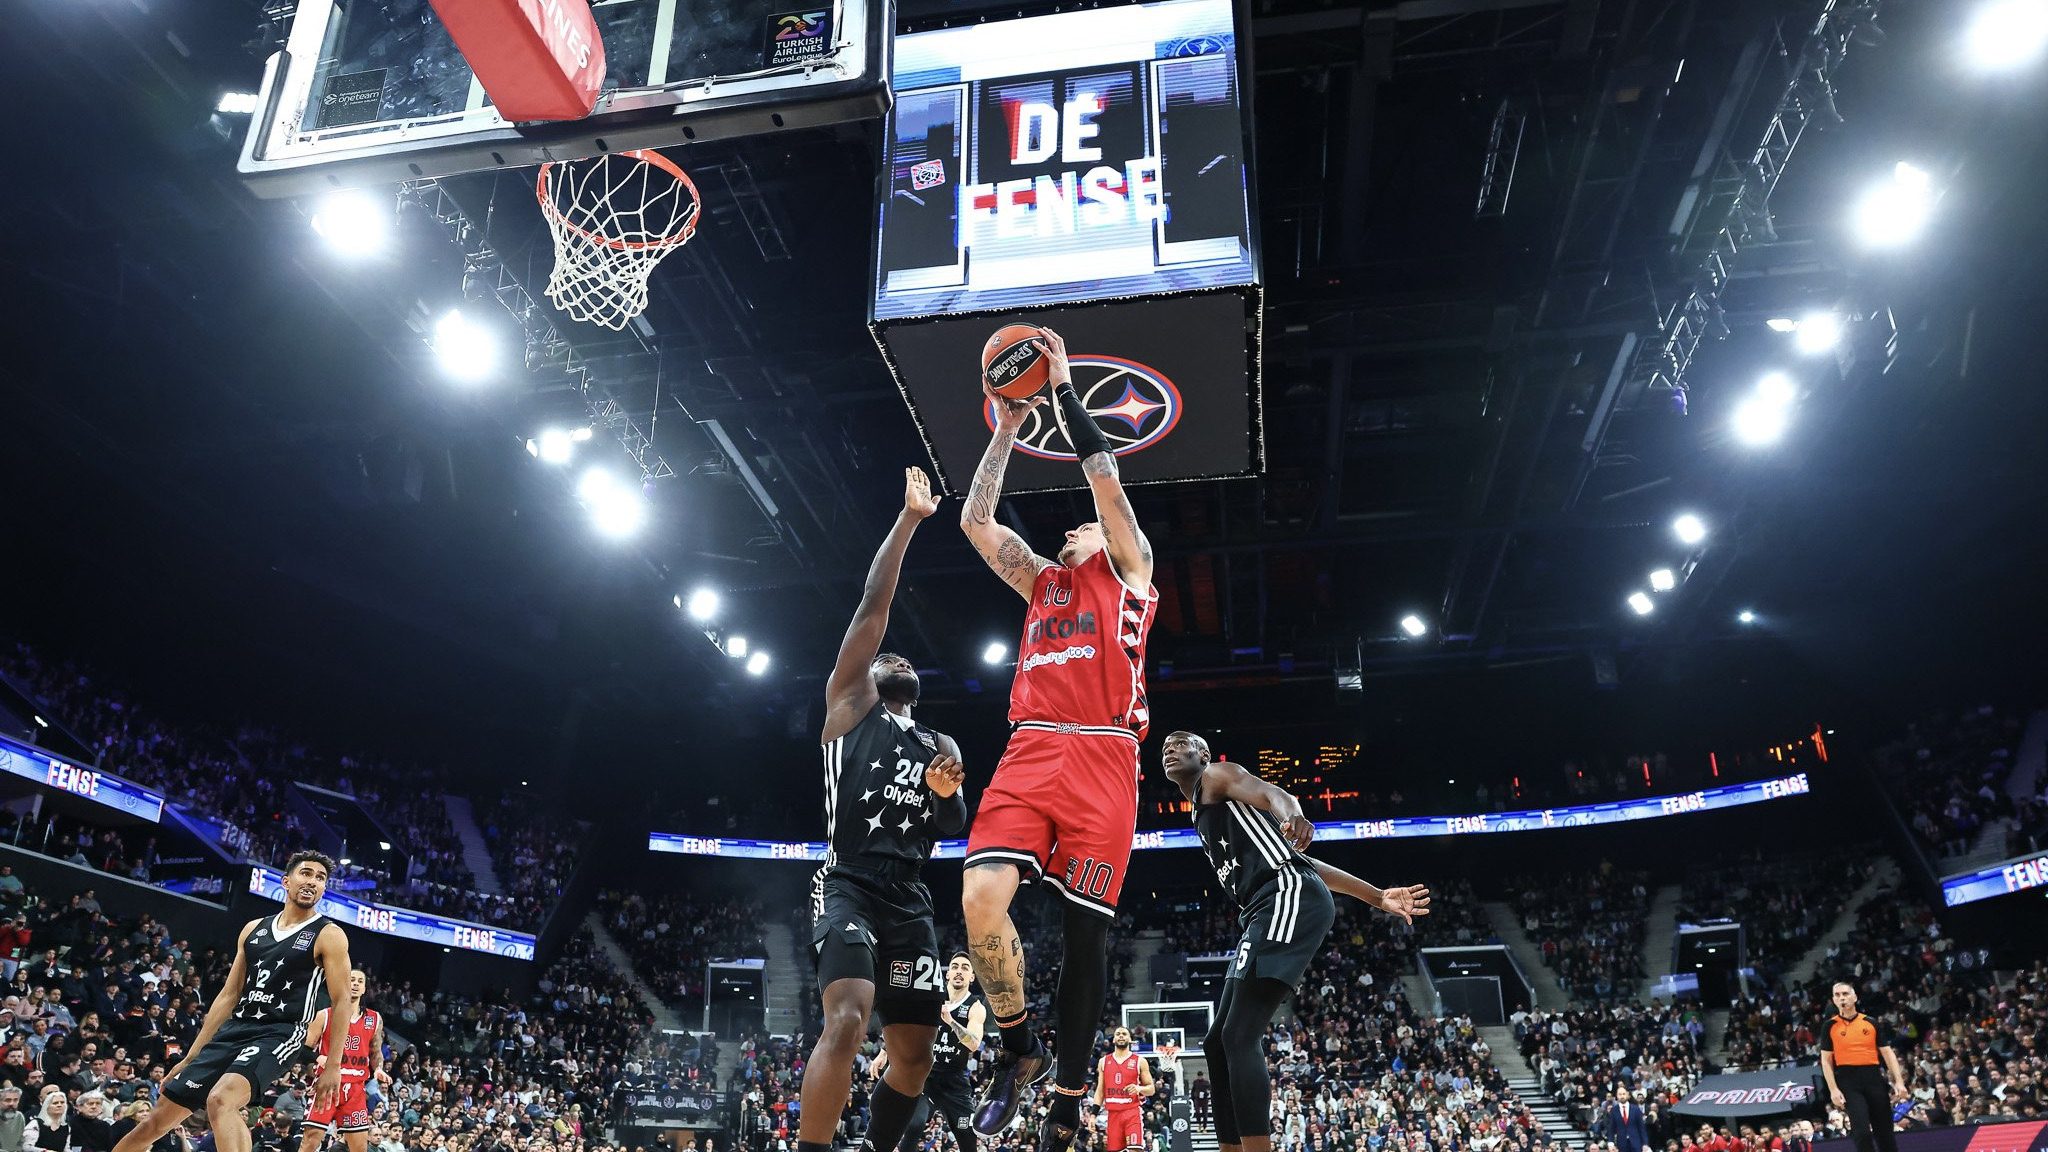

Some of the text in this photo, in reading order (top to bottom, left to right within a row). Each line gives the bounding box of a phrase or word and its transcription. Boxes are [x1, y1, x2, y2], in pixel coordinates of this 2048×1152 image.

[539, 0, 591, 68] INES
[776, 36, 823, 49] TURKISH
[774, 44, 823, 57] AIRLINES
[339, 91, 379, 103] oneteam
[1011, 92, 1102, 165] DÉ
[959, 157, 1165, 246] FENSE
[989, 342, 1033, 382] SPALDING
[48, 761, 101, 796] FENSE
[894, 759, 924, 788] 24
[883, 785, 924, 808] OlyBet
[1762, 773, 1809, 799] FENSE
[1661, 792, 1706, 815] FENSE
[1355, 819, 1396, 838] FENSE
[1447, 815, 1487, 833] FENSE
[683, 838, 722, 854] FENSE
[770, 843, 809, 859] FENSE
[1134, 831, 1165, 849] ENSE
[1075, 857, 1114, 899] 10
[356, 905, 397, 932] FENSE
[454, 926, 496, 951] FENSE
[893, 962, 911, 974] 25
[913, 955, 944, 992] 24
[1687, 1081, 1815, 1104] PARIS
[352, 1110, 369, 1127] 32
